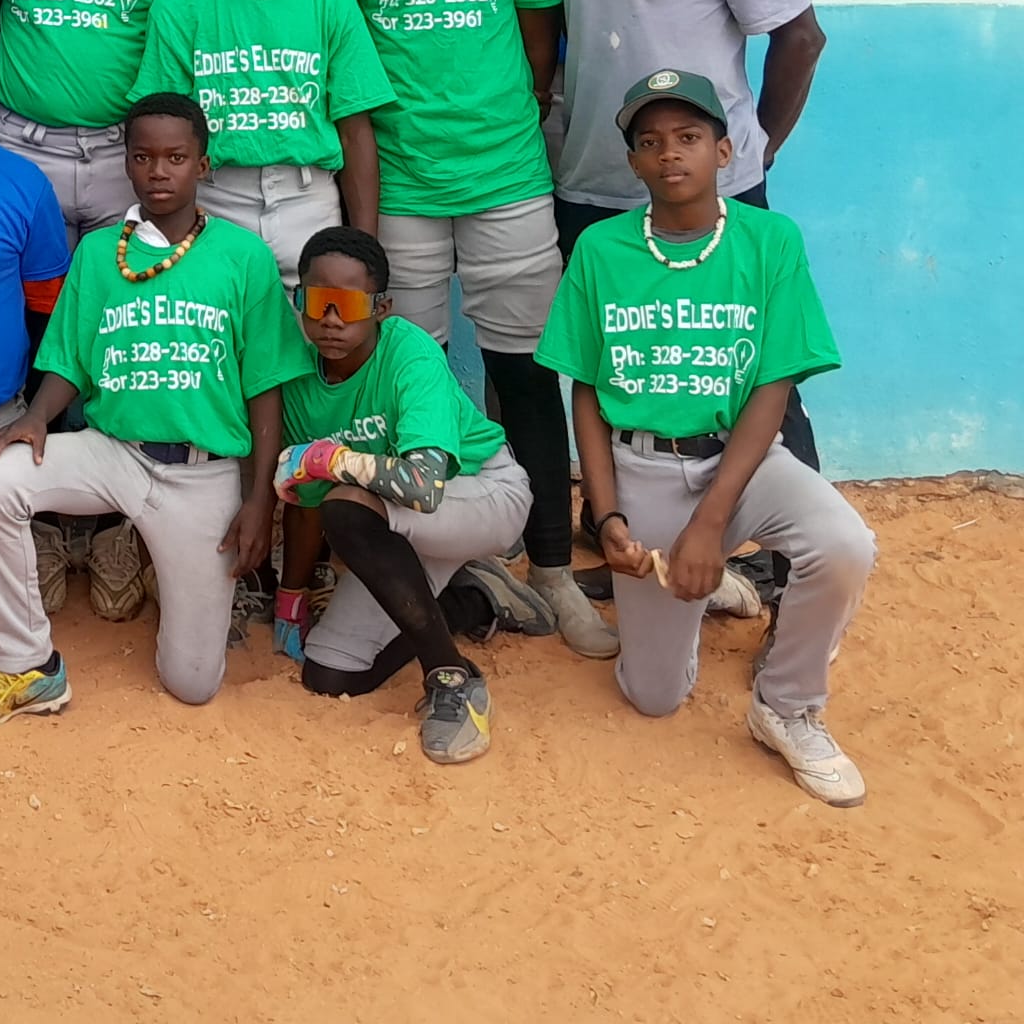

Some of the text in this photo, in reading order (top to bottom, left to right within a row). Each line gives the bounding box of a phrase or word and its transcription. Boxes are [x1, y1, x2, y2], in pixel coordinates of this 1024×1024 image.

[32, 7, 108, 29] 323-3961
[402, 10, 483, 31] 323-3961
[193, 44, 321, 77] EDDIE'S ELECTRIC
[198, 88, 226, 108] Ph:
[227, 111, 306, 131] 323-3961
[154, 294, 229, 333] ELECTRIC
[604, 298, 758, 333] EDDIE'S ELECTRIC
[130, 341, 210, 363] 328-2362
[610, 345, 646, 368] Ph:
[625, 373, 731, 396] or 323-3961
